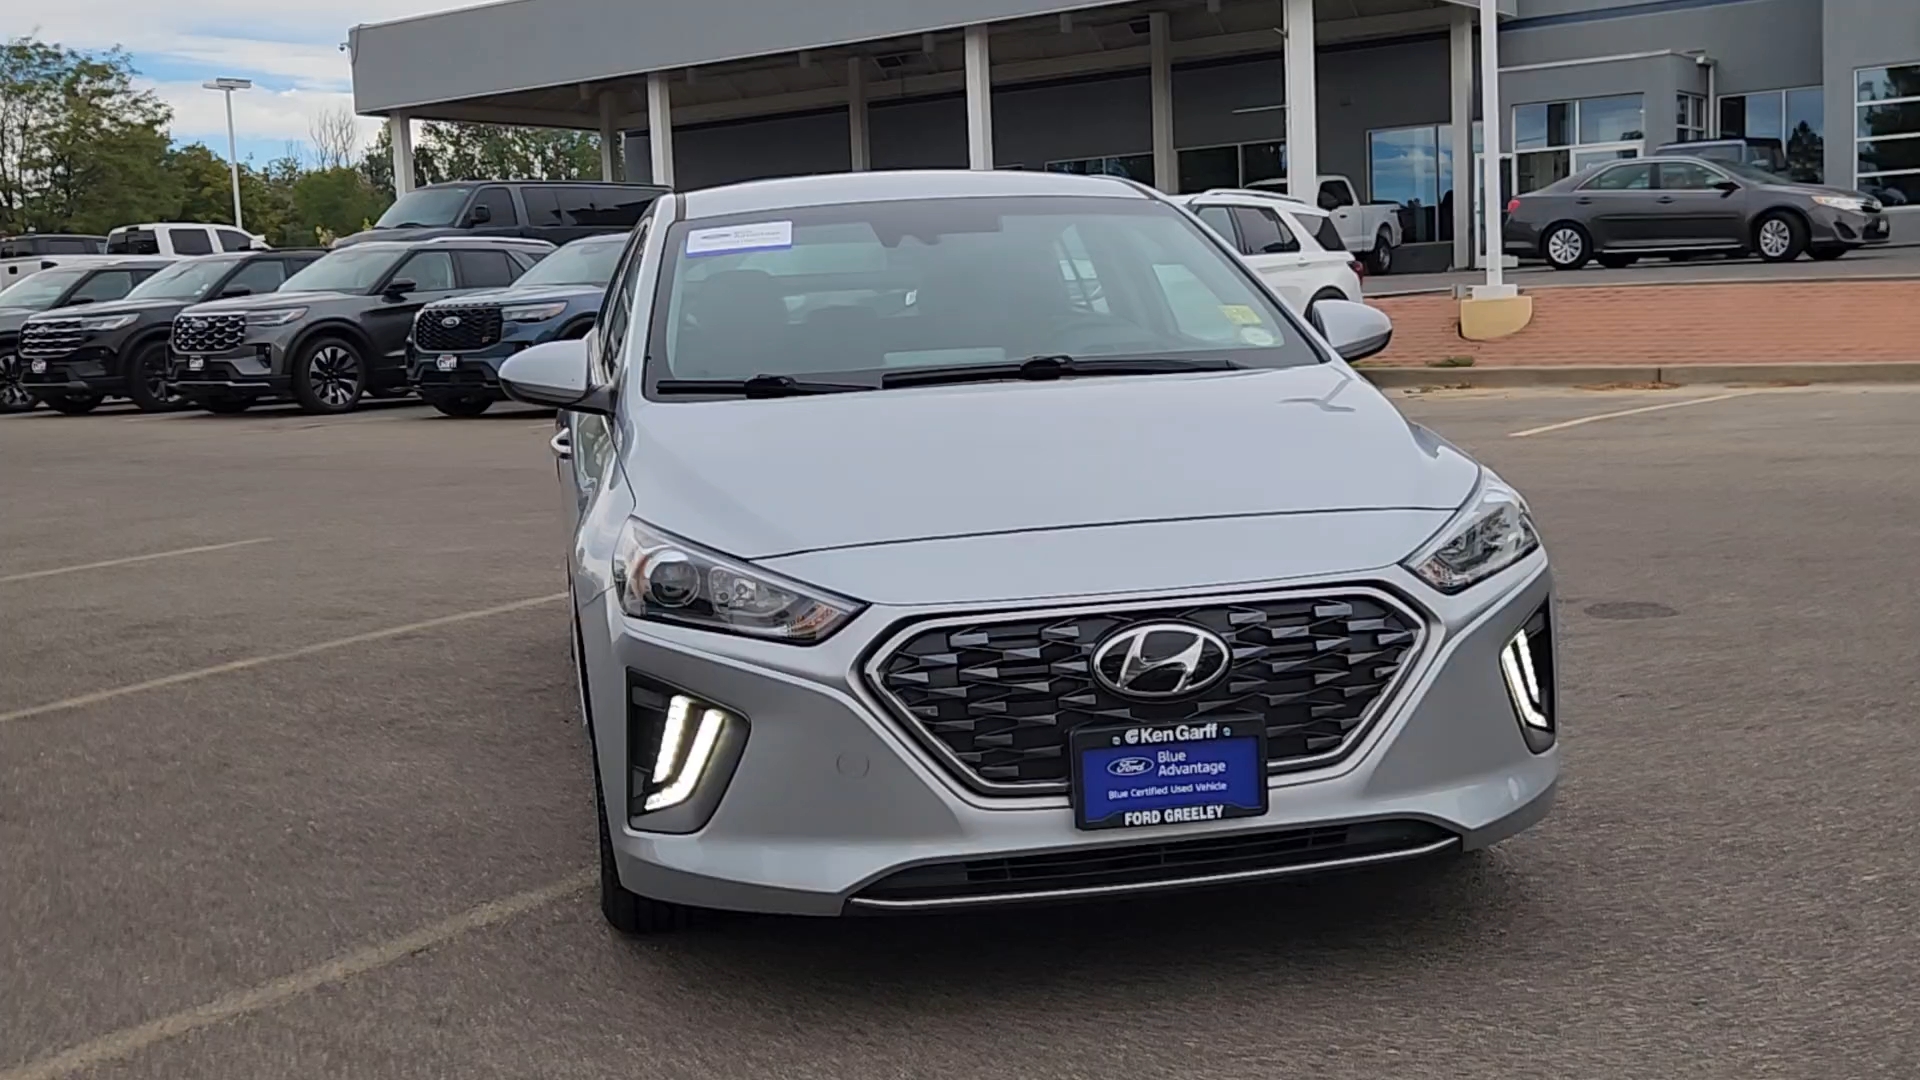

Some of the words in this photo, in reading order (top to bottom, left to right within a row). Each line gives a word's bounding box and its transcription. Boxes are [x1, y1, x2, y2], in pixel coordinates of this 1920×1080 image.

[1141, 728, 1174, 743] Ken
[1176, 723, 1218, 740] Garff
[1158, 751, 1186, 762] Blue
[1117, 761, 1145, 773] Ford
[1158, 761, 1226, 776] Advantage
[1108, 791, 1128, 799] Blue
[1130, 787, 1168, 796] Certified
[1171, 785, 1193, 794] Used
[1196, 782, 1227, 792] Vehicle
[1124, 812, 1161, 826] FORD
[1164, 805, 1224, 822] GREELEY
